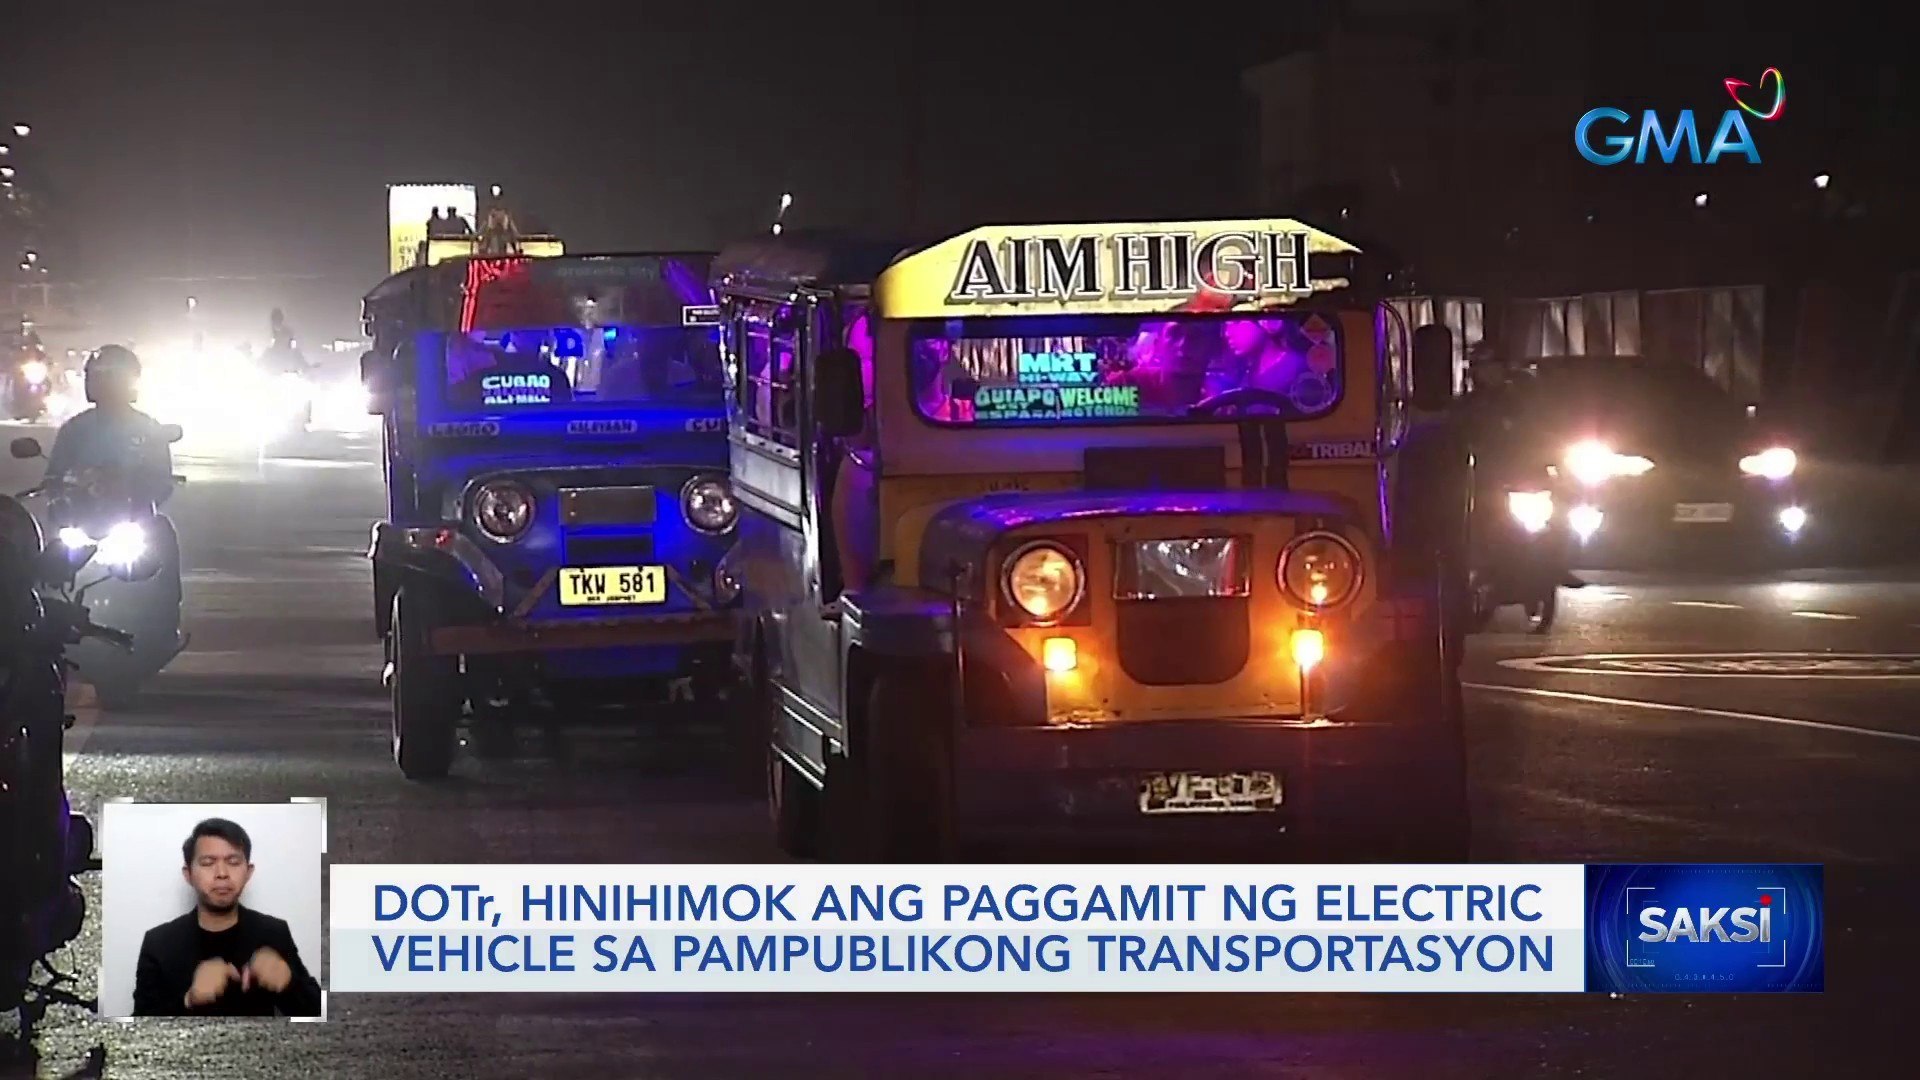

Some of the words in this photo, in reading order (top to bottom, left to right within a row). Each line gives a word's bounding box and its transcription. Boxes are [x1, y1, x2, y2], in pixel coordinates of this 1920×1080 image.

[950, 233, 1104, 301] AIM
[1112, 229, 1312, 296] HIGH
[1019, 352, 1096, 373] MRT
[482, 374, 550, 389] CUBAO
[975, 386, 1055, 407] QUIAPO
[1059, 386, 1139, 408] WELCOME
[569, 573, 606, 595] TKW
[619, 572, 654, 593] 581
